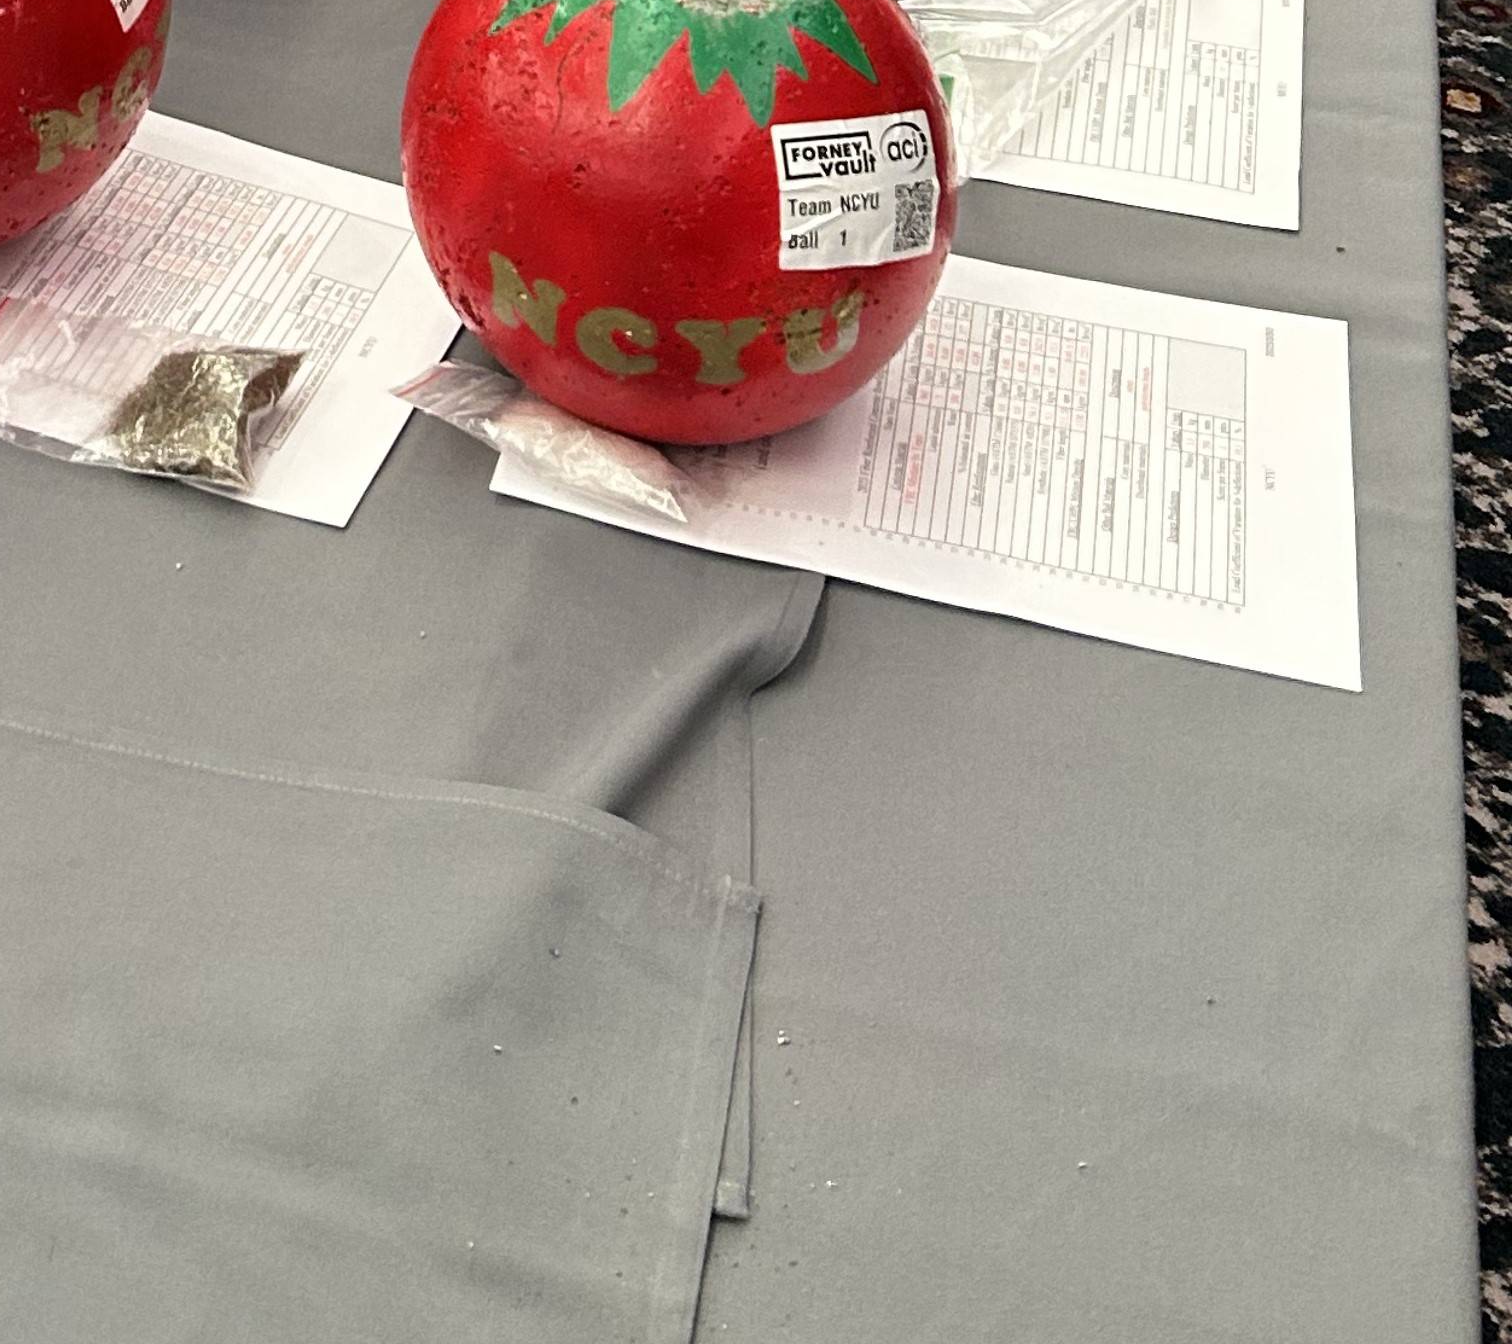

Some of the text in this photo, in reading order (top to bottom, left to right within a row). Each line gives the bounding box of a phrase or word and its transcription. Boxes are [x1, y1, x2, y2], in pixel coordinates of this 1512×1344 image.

[791, 138, 922, 162] FORNEY aci
[819, 150, 876, 176] vault
[788, 192, 881, 218] Team NCYU
[838, 229, 849, 248] 1
[489, 251, 866, 385] NCYU
